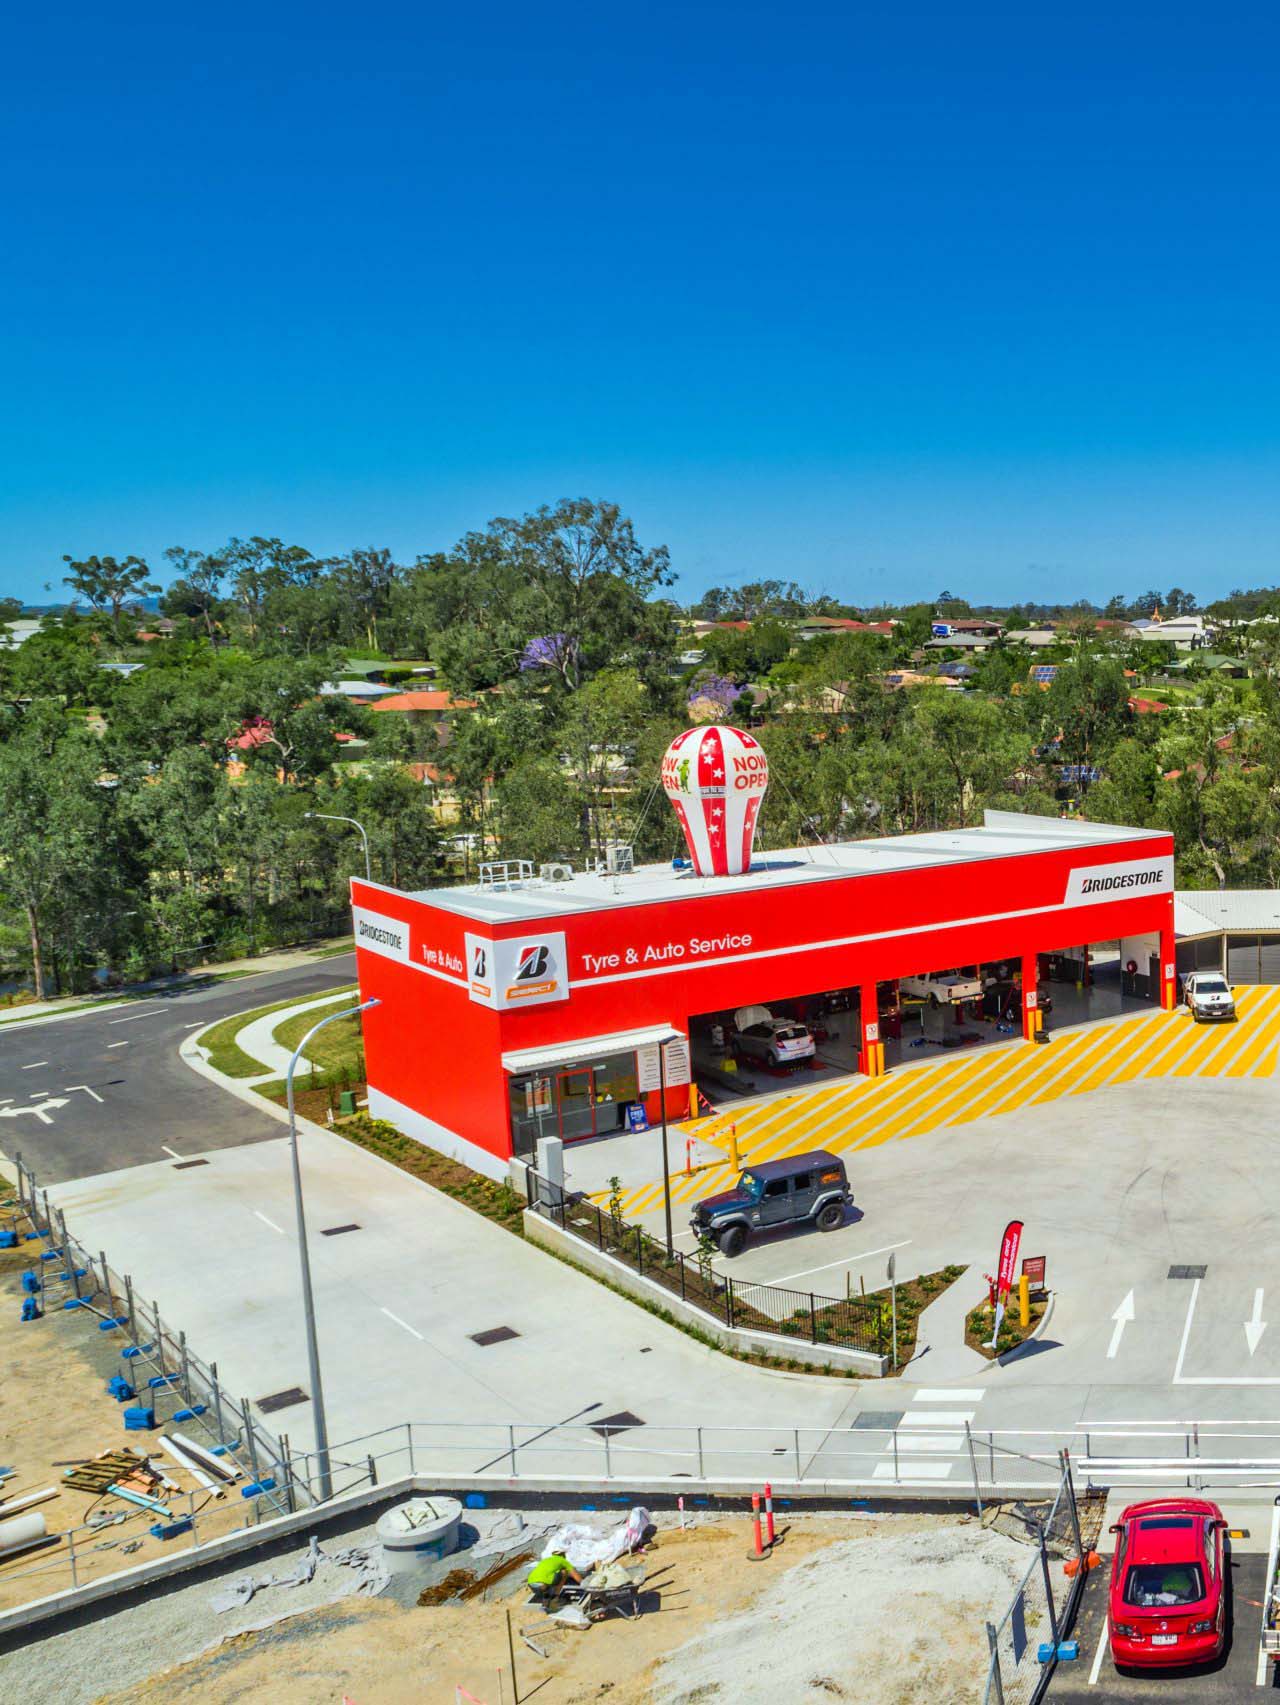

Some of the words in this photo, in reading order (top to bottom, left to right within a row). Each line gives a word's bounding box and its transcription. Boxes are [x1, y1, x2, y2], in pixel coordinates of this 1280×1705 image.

[733, 755, 766, 772] NOW
[1081, 870, 1163, 894] BRIDGESTONE
[359, 920, 402, 950] BRIDGESTONE
[422, 944, 437, 964] Tyre
[438, 950, 444, 966] &
[445, 953, 463, 973] Auto
[582, 954, 620, 973] Tyre
[625, 948, 638, 964] &
[643, 942, 685, 962] Auto
[689, 933, 752, 954] Service
